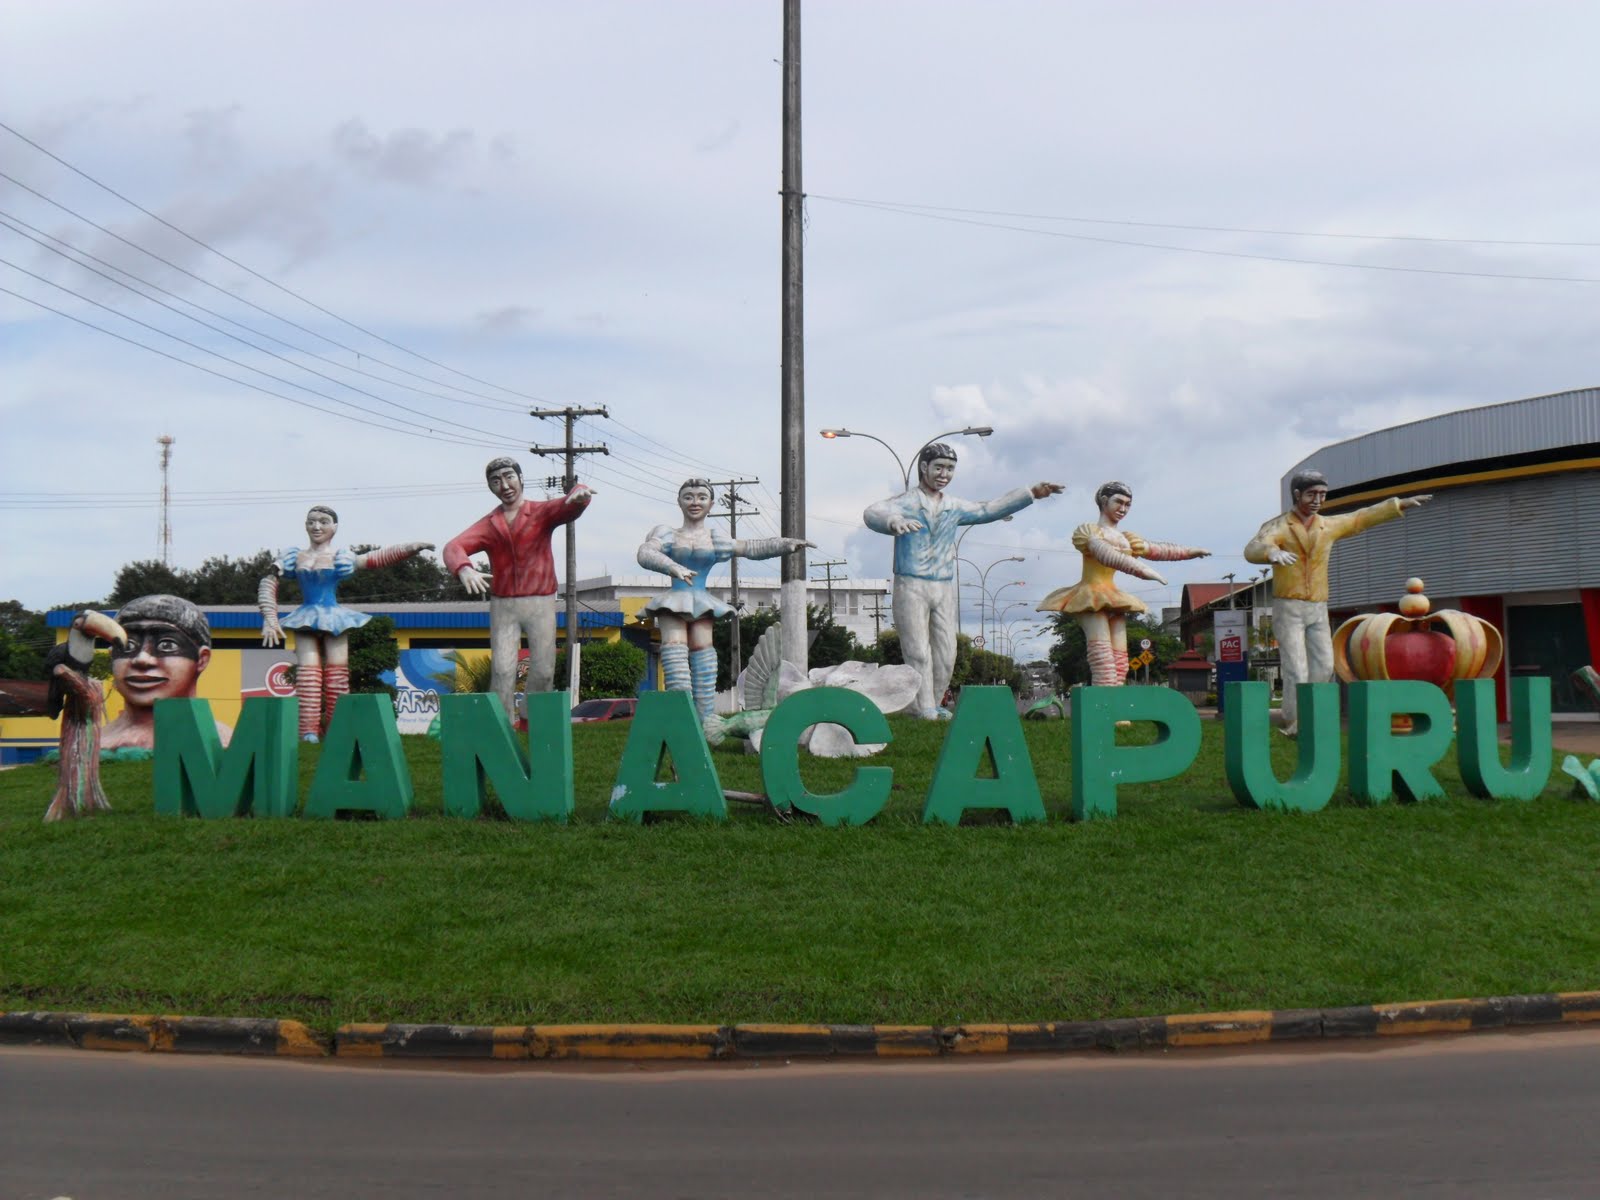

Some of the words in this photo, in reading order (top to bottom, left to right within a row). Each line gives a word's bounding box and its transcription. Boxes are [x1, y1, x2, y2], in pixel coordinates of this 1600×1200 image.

[1221, 640, 1239, 648] PAC
[394, 689, 440, 713] ARA
[153, 676, 1552, 825] MANACAPURU
